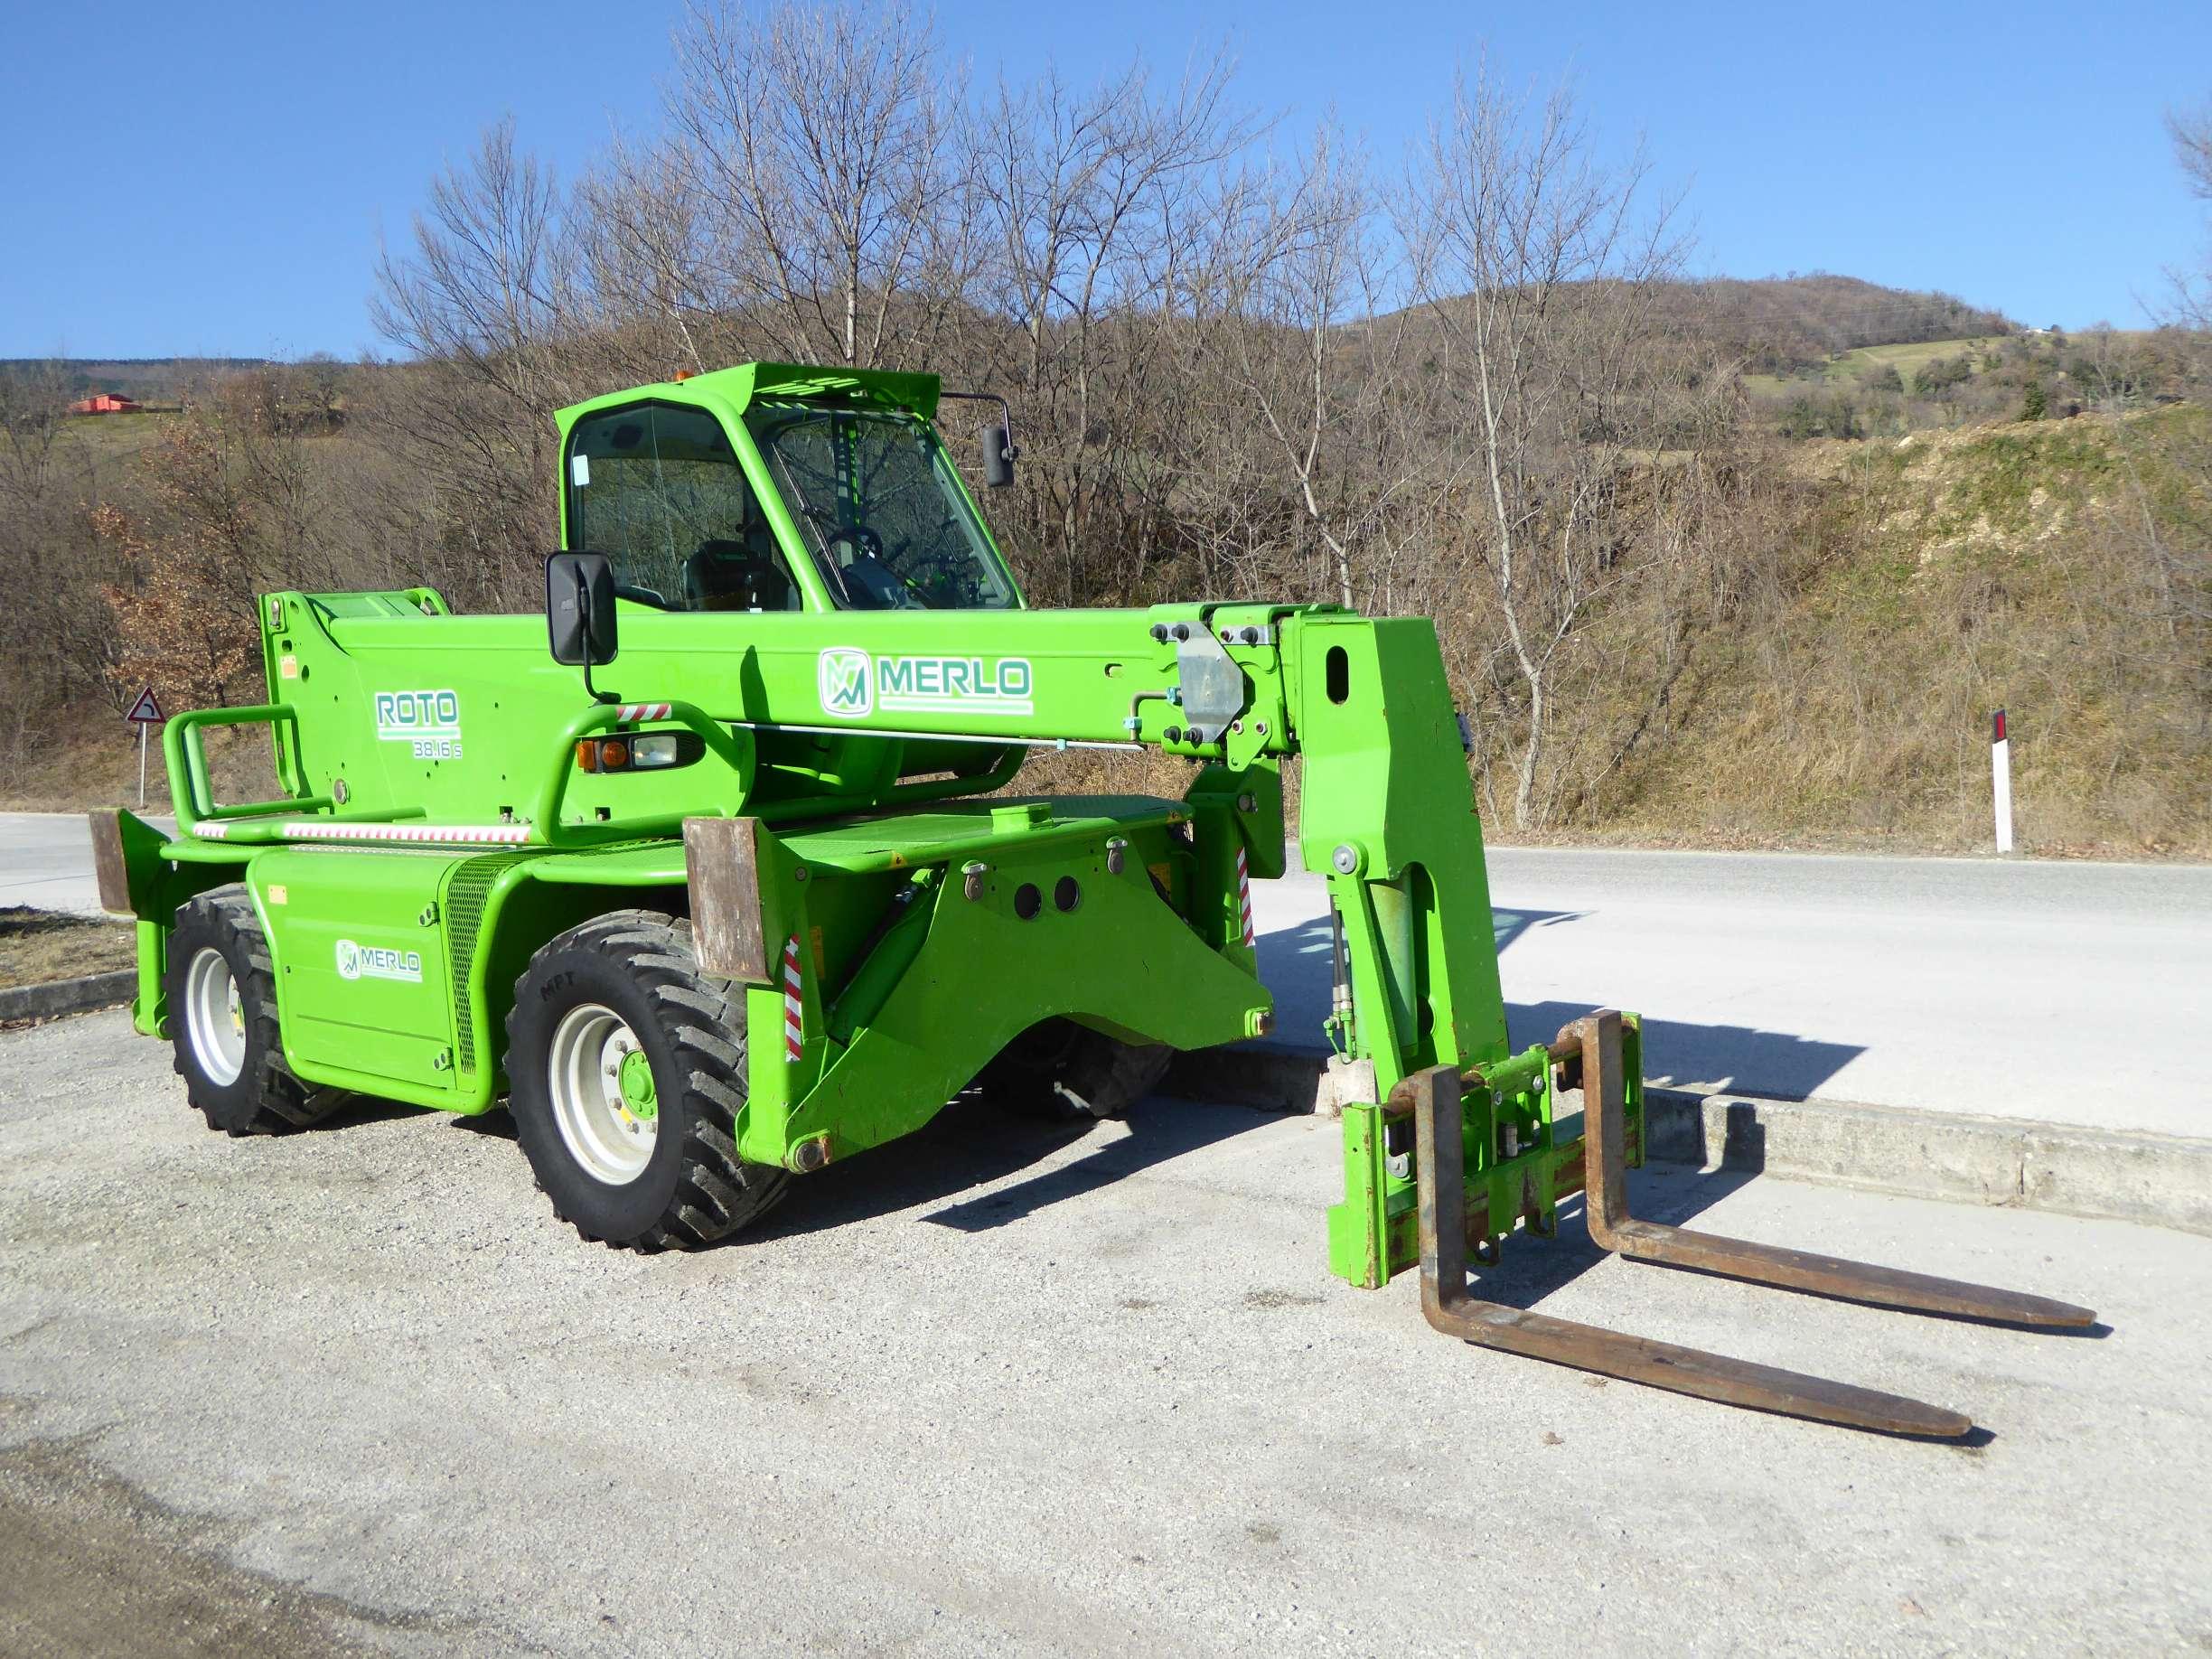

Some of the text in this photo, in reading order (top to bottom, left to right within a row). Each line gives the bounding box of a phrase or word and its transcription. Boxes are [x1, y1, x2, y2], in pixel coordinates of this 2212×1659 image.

[879, 660, 1030, 695] MERLO
[376, 691, 458, 725] ROTO
[414, 741, 450, 757] 38.16
[361, 948, 420, 972] MERLO
[540, 970, 576, 1002] MPT
